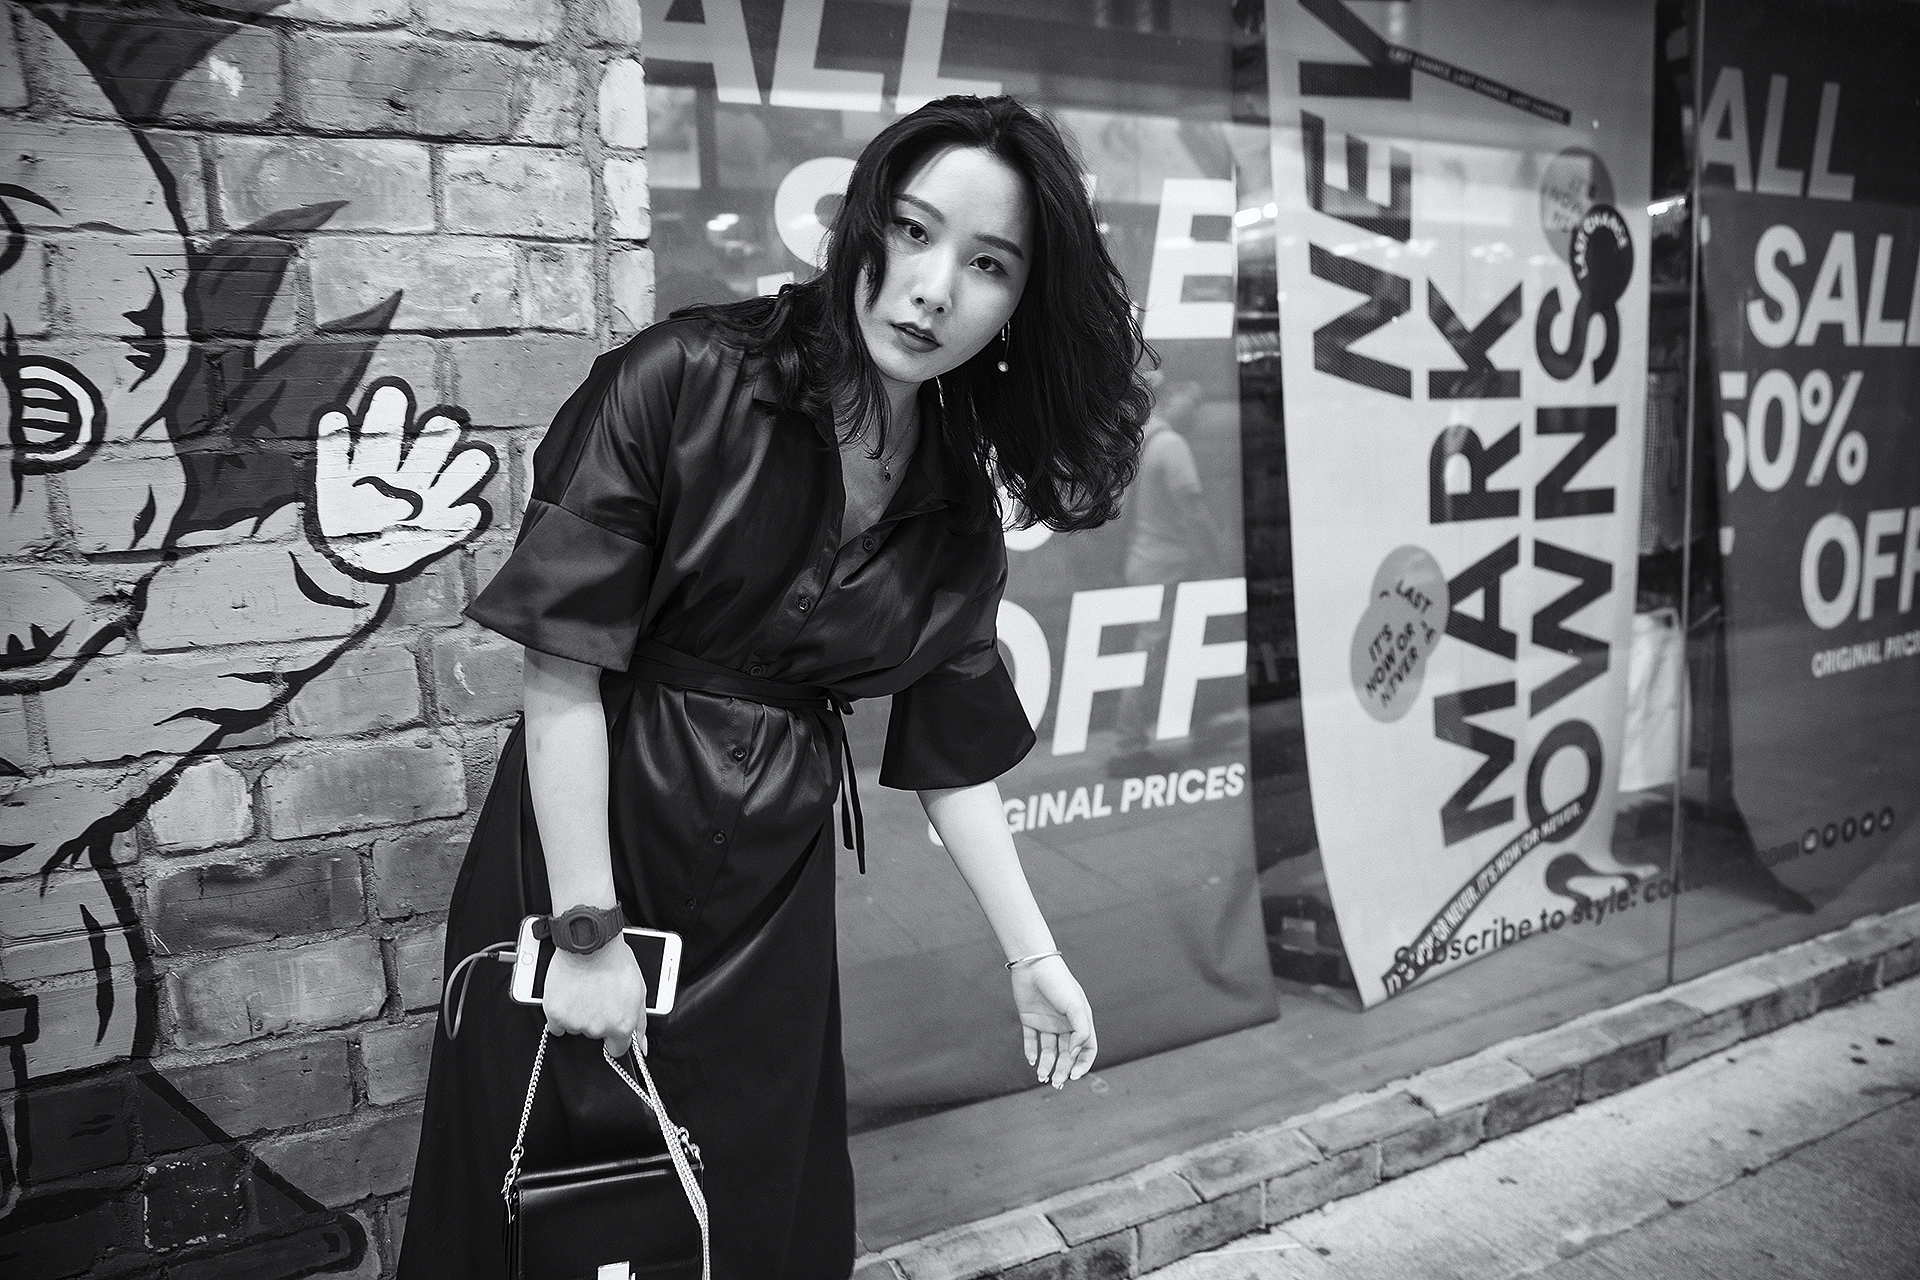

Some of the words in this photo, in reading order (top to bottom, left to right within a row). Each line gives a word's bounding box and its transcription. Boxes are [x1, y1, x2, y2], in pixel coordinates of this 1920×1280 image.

[1701, 66, 1856, 200] ALL
[1574, 230, 1589, 281] LAST
[1430, 281, 1523, 848] MARK
[1395, 578, 1434, 616] LAST
[1365, 647, 1397, 697] NOW
[1396, 621, 1416, 652] OR
[1368, 621, 1394, 663] IT'S
[1120, 762, 1247, 815] PRICES
[1540, 908, 1567, 933] to
